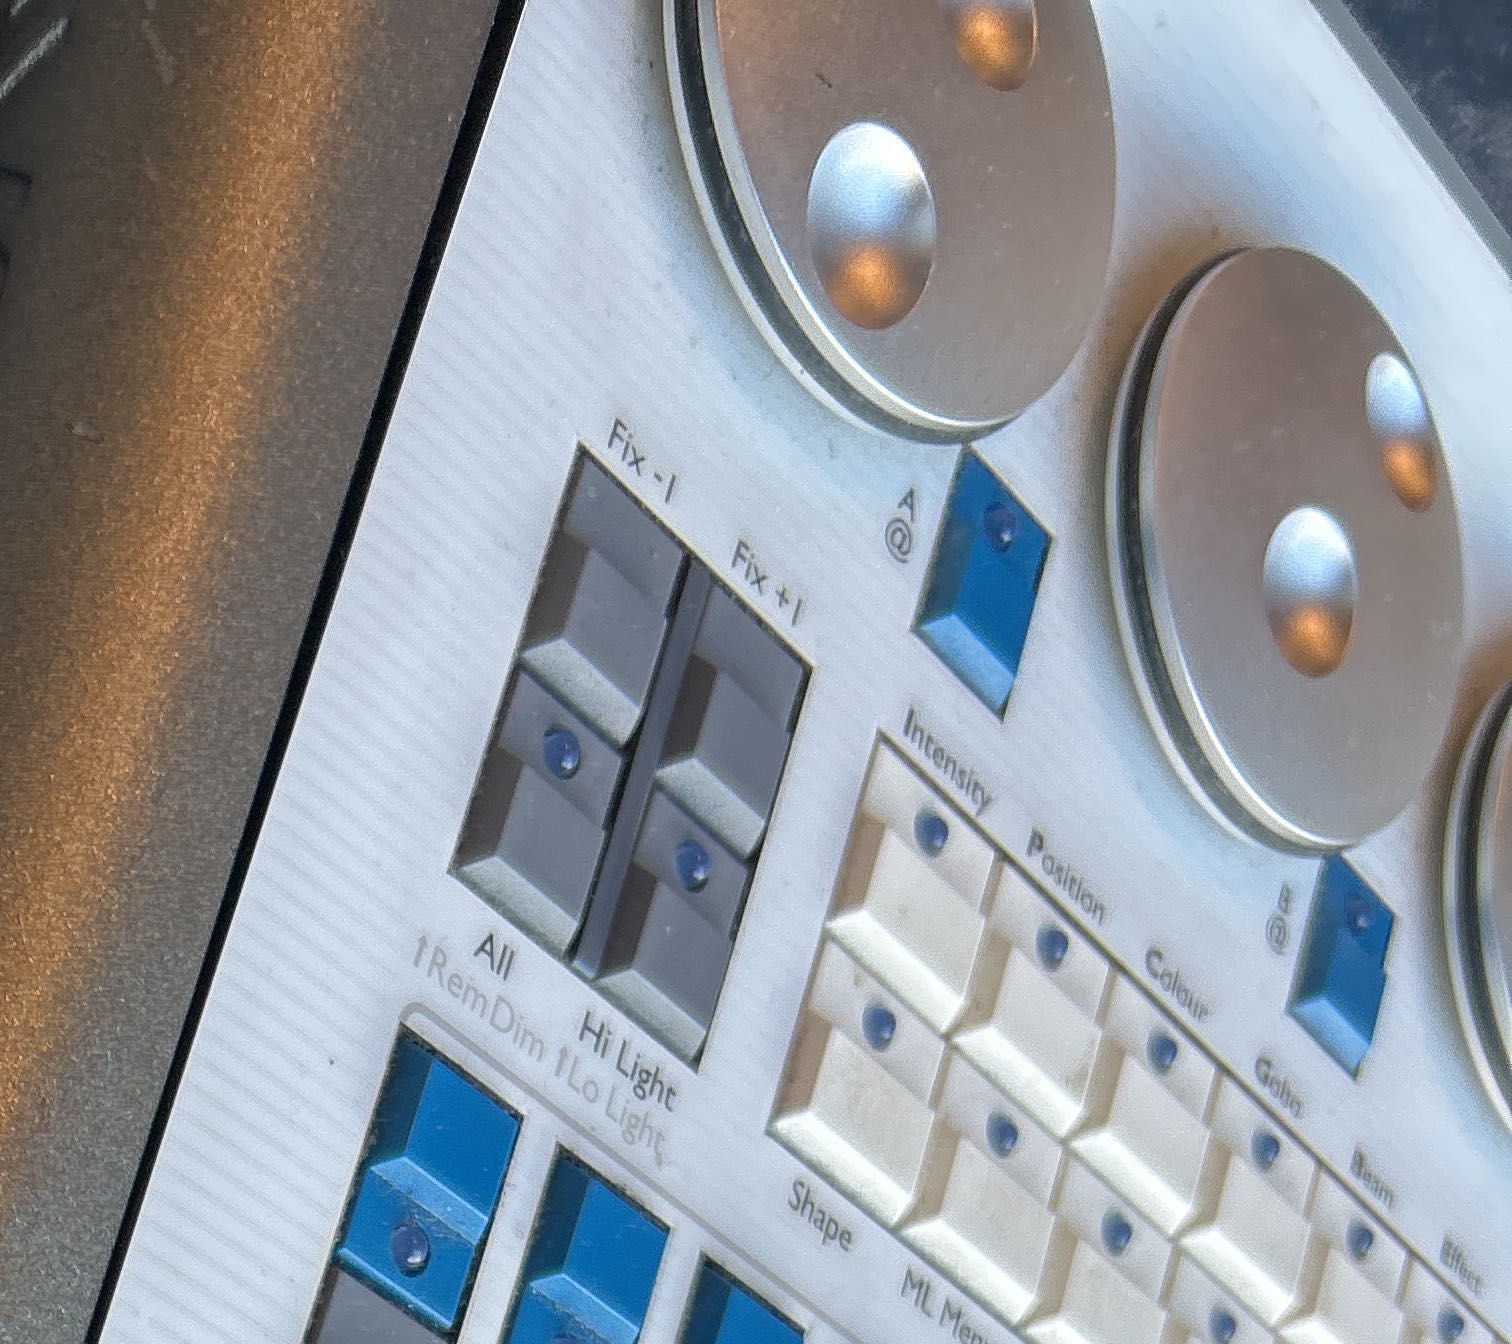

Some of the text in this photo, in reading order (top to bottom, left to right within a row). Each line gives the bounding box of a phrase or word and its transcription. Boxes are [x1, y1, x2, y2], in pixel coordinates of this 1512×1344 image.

[607, 415, 645, 477] Fix
[731, 538, 768, 596] Fix
[902, 706, 996, 817] Intensity
[1026, 826, 1107, 924] Position
[473, 933, 516, 981] All
[578, 1009, 678, 1113] Hi Light
[604, 1086, 666, 1168] Light
[788, 1180, 853, 1252] Shape
[901, 1264, 934, 1319] ML
